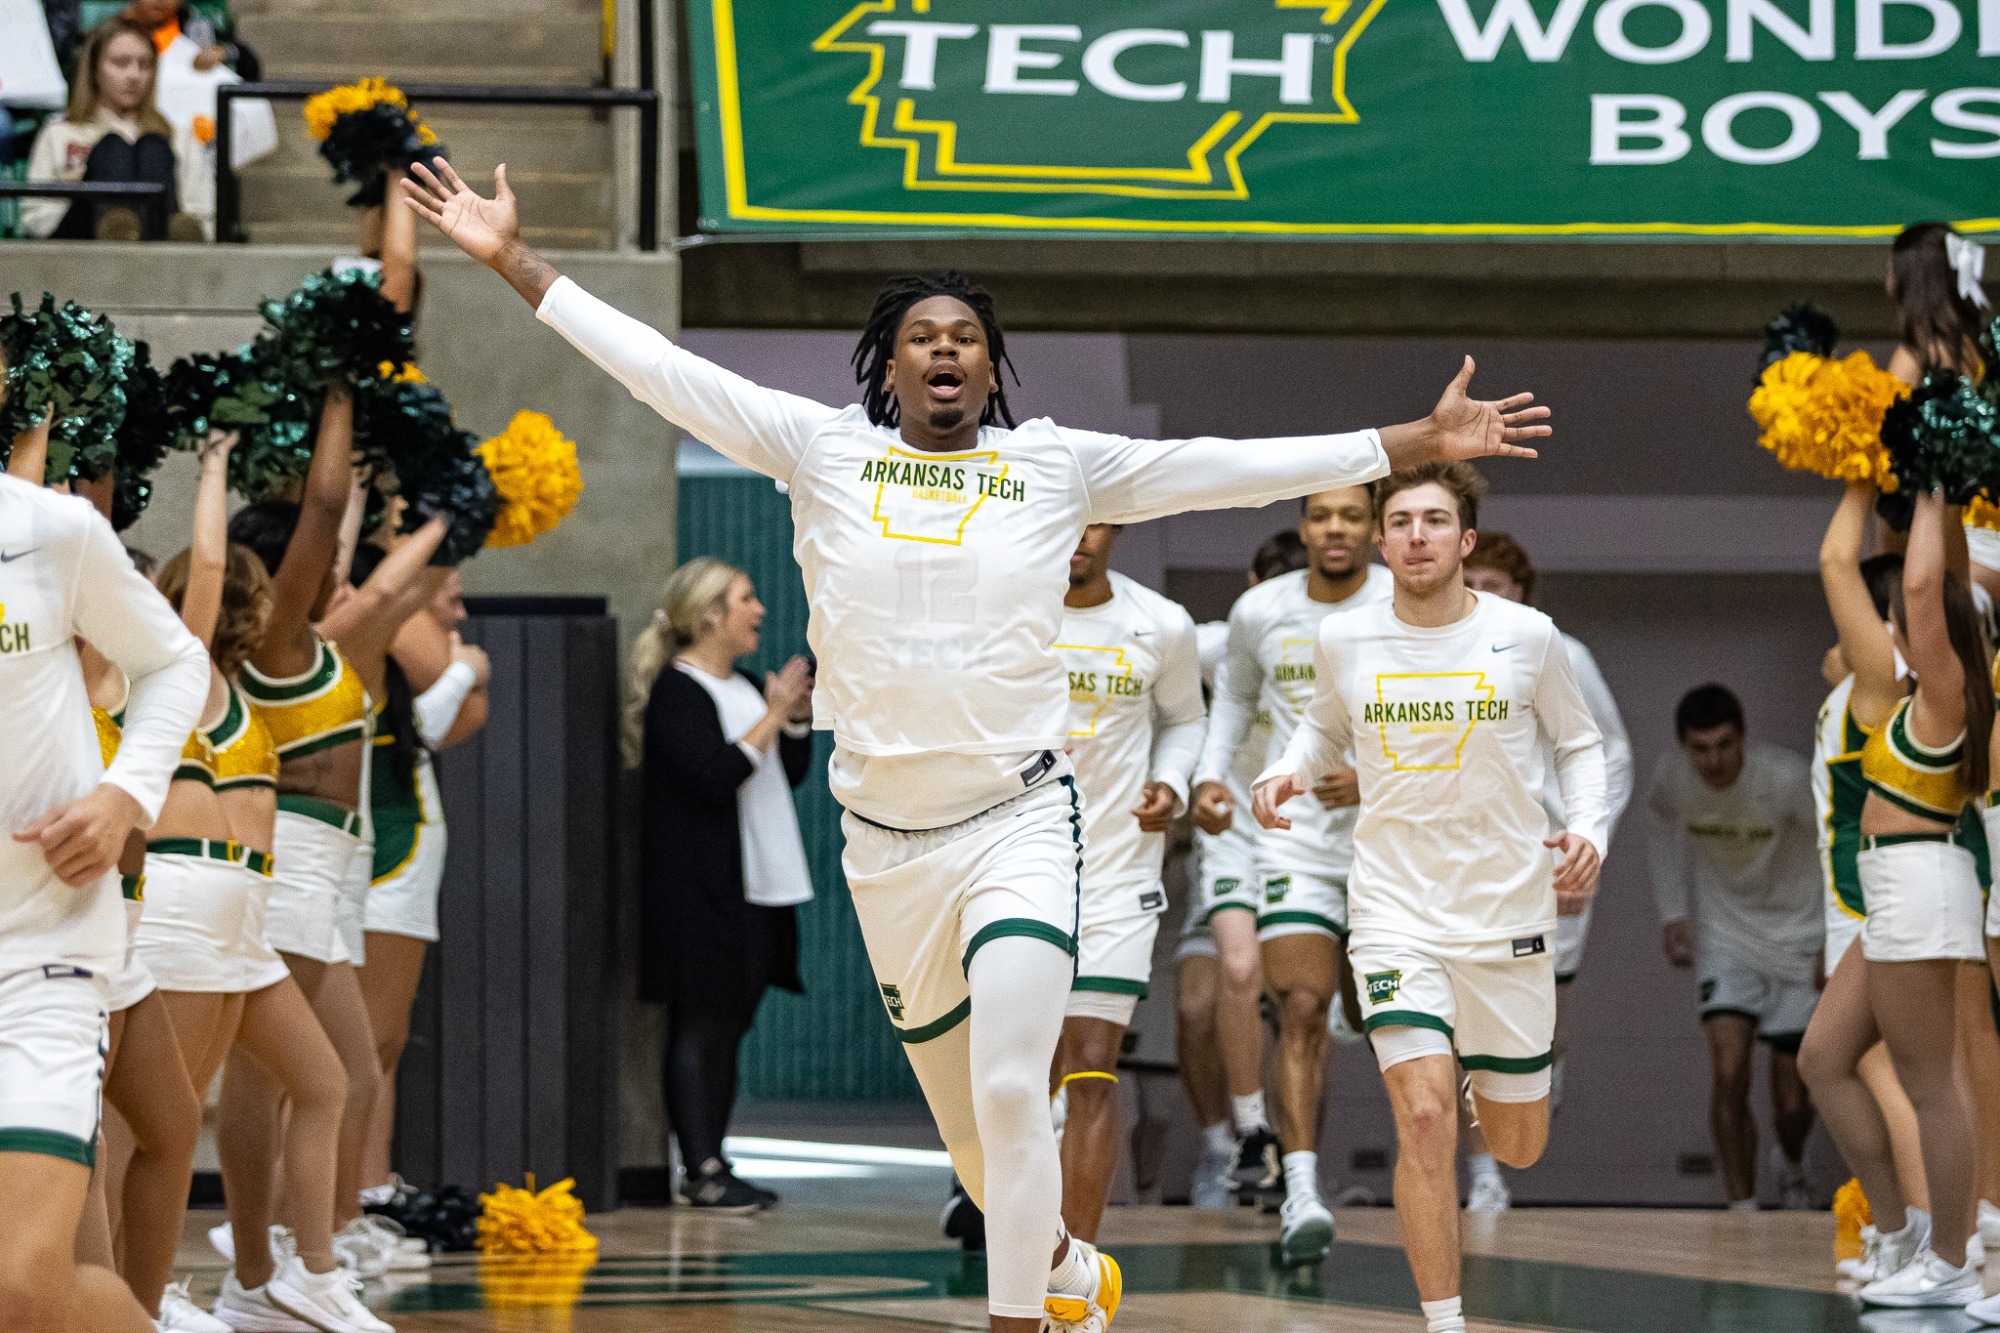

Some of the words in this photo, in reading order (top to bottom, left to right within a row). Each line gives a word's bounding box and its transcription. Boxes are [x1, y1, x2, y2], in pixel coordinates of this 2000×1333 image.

[869, 20, 1315, 104] TECH
[1588, 86, 2000, 165] BOYS
[860, 460, 965, 490] ARKANSAS
[976, 472, 1025, 502] TECH
[0, 623, 30, 653] CH
[1106, 674, 1143, 695] TECH
[1364, 701, 1454, 723] ARKANSAS
[1465, 700, 1508, 720] TECH
[1368, 979, 1398, 994] TECH
